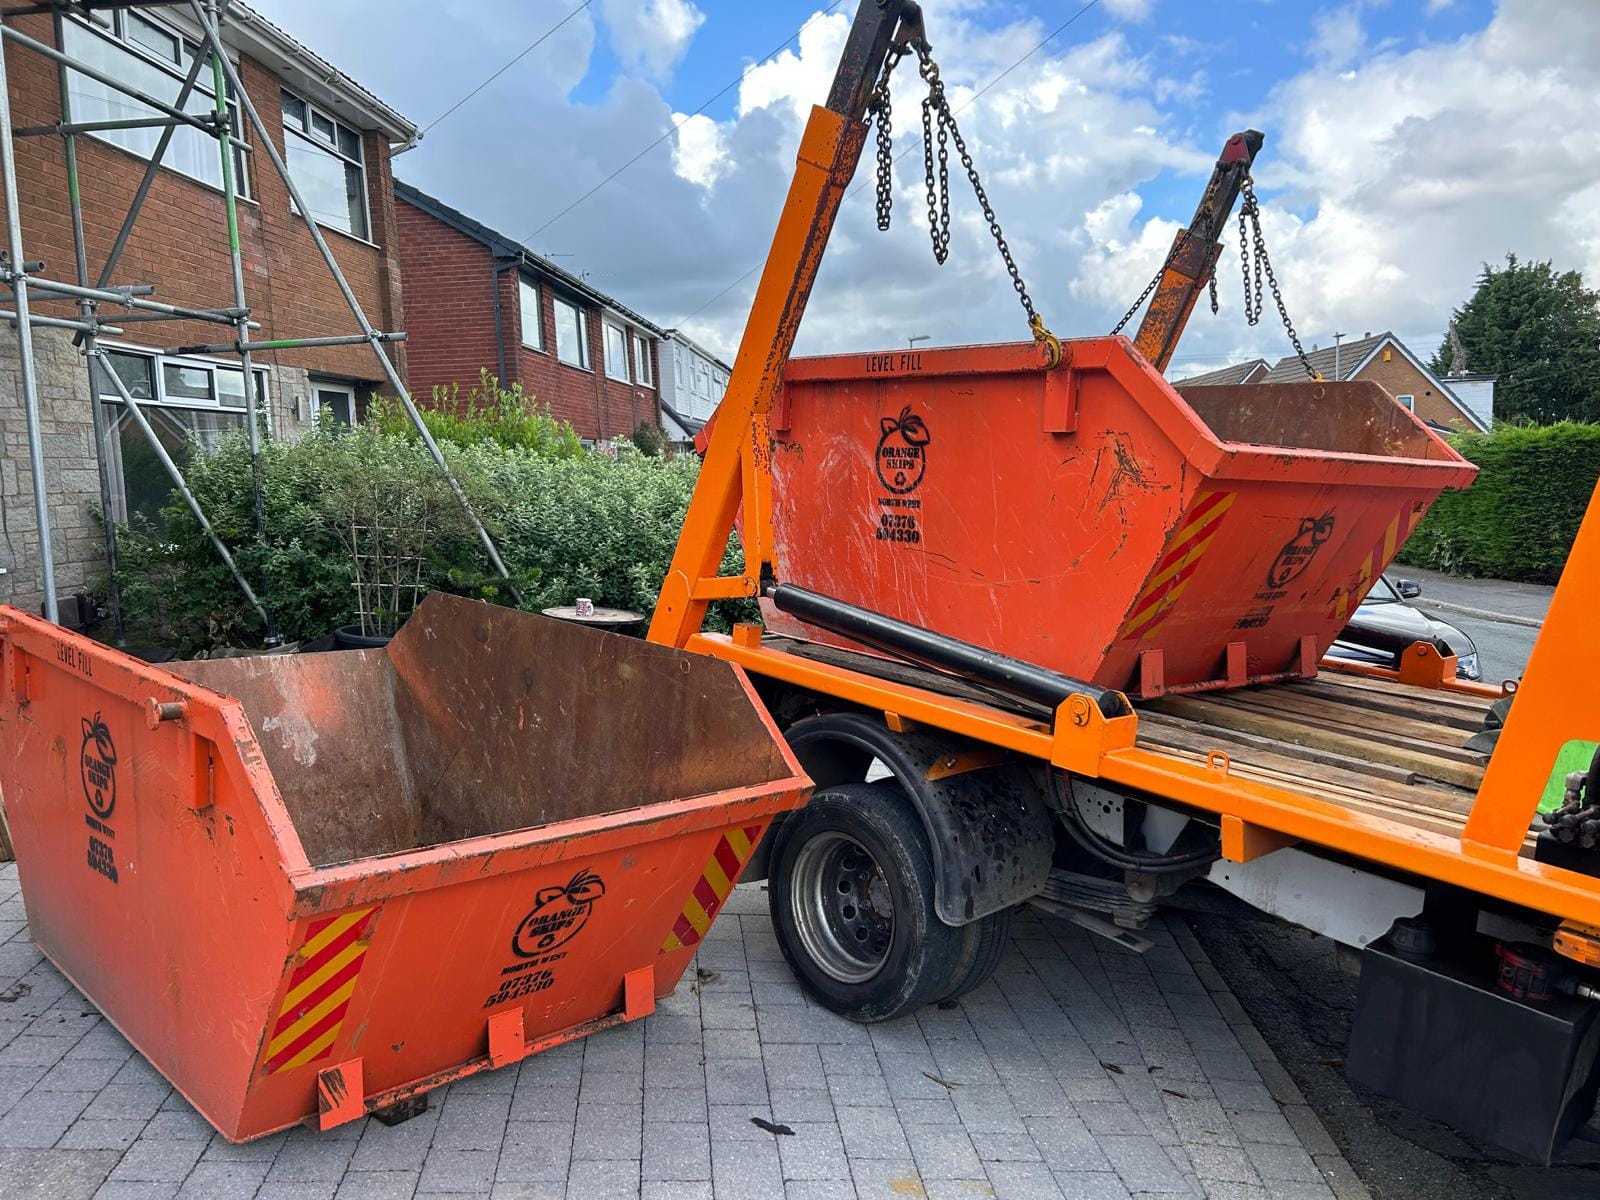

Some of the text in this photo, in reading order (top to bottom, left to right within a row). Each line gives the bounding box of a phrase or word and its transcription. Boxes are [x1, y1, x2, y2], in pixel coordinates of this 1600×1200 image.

[866, 354, 922, 372] LEVEL FILL
[881, 447, 920, 459] ORANGE
[886, 459, 914, 469] SKIPS
[57, 644, 92, 677] LEVEL FILL
[528, 905, 585, 927] ORANGE
[529, 918, 574, 937] SKIPS
[499, 968, 553, 992] 07376
